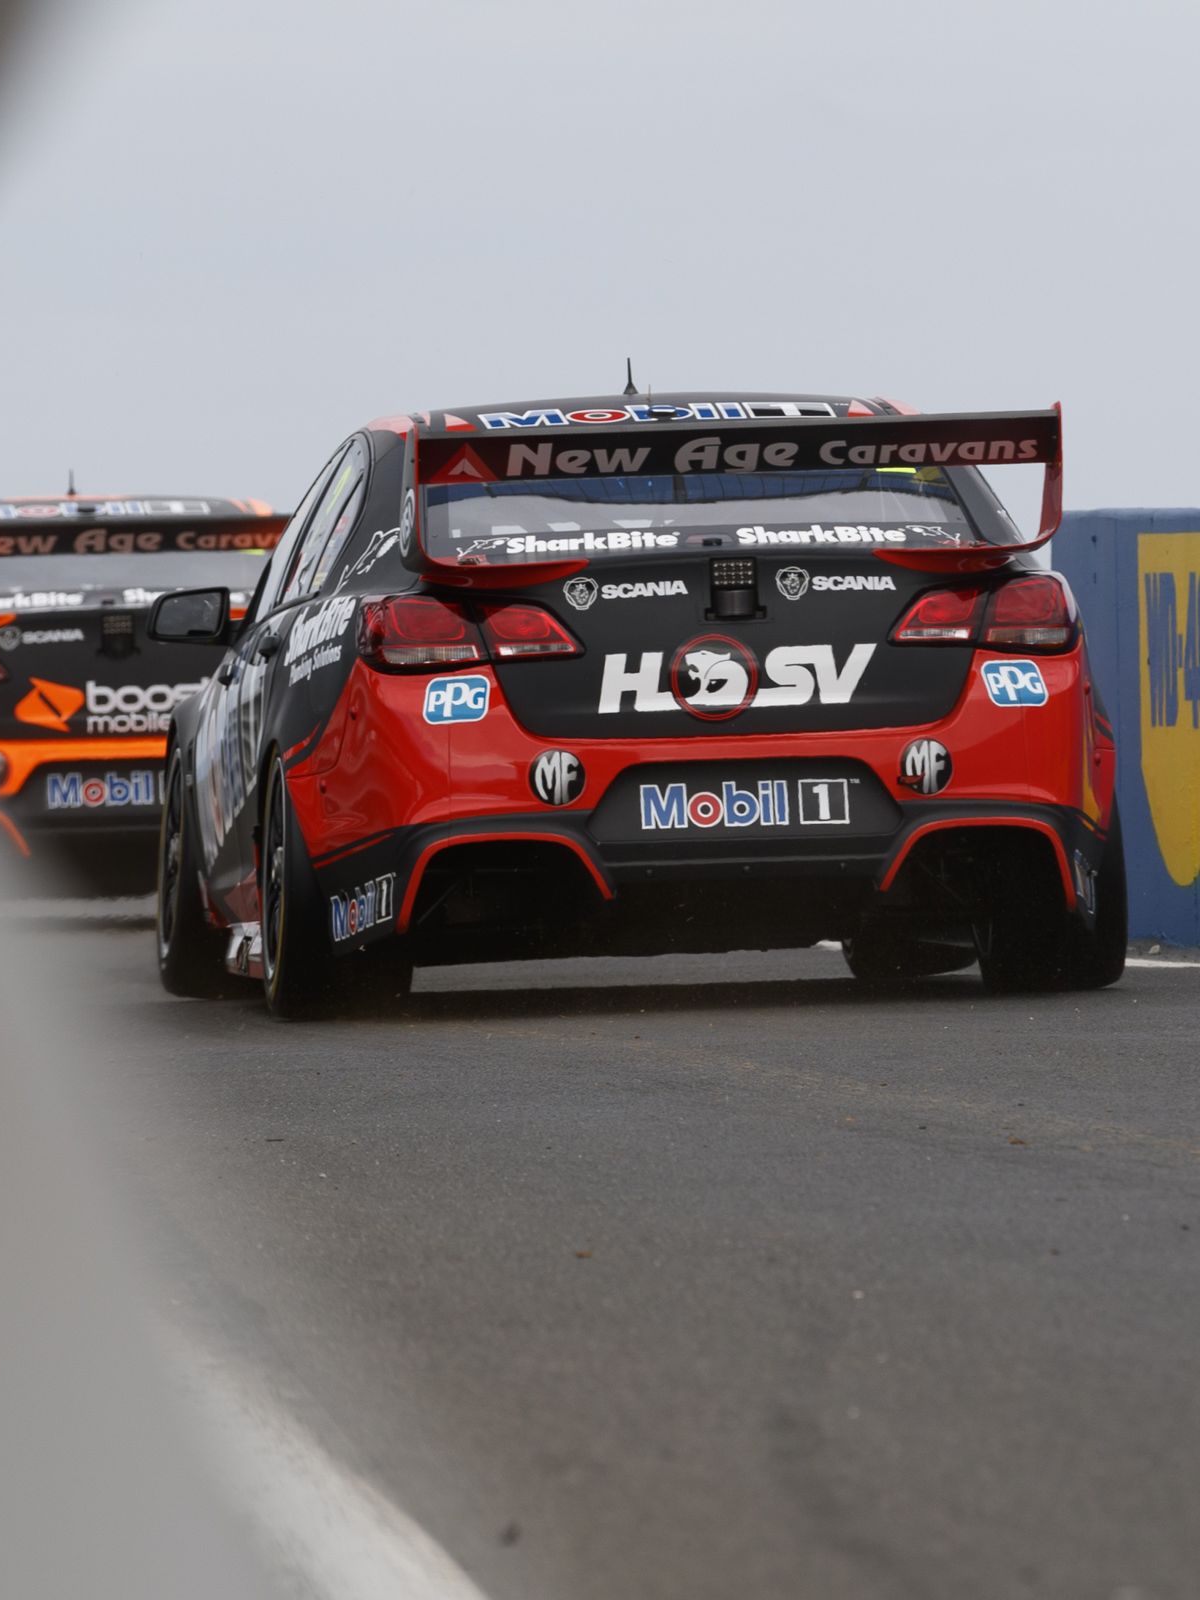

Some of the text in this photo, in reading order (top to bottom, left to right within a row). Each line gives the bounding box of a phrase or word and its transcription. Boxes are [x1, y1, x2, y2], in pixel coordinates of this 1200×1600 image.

[478, 402, 747, 430] Mobil
[506, 437, 1038, 477] New Age Caravans
[73, 528, 163, 554] Age
[175, 530, 282, 550] Carav
[506, 531, 681, 555] SharkBite
[736, 525, 907, 546] SharkBite
[601, 580, 688, 599] SCANIA
[812, 575, 896, 591] SCANIA
[987, 666, 1044, 701] PPG
[428, 683, 485, 717] PPG
[86, 711, 170, 733] mobile
[47, 770, 154, 809] Mobil
[534, 751, 580, 804] MF
[640, 779, 789, 829] Mobil
